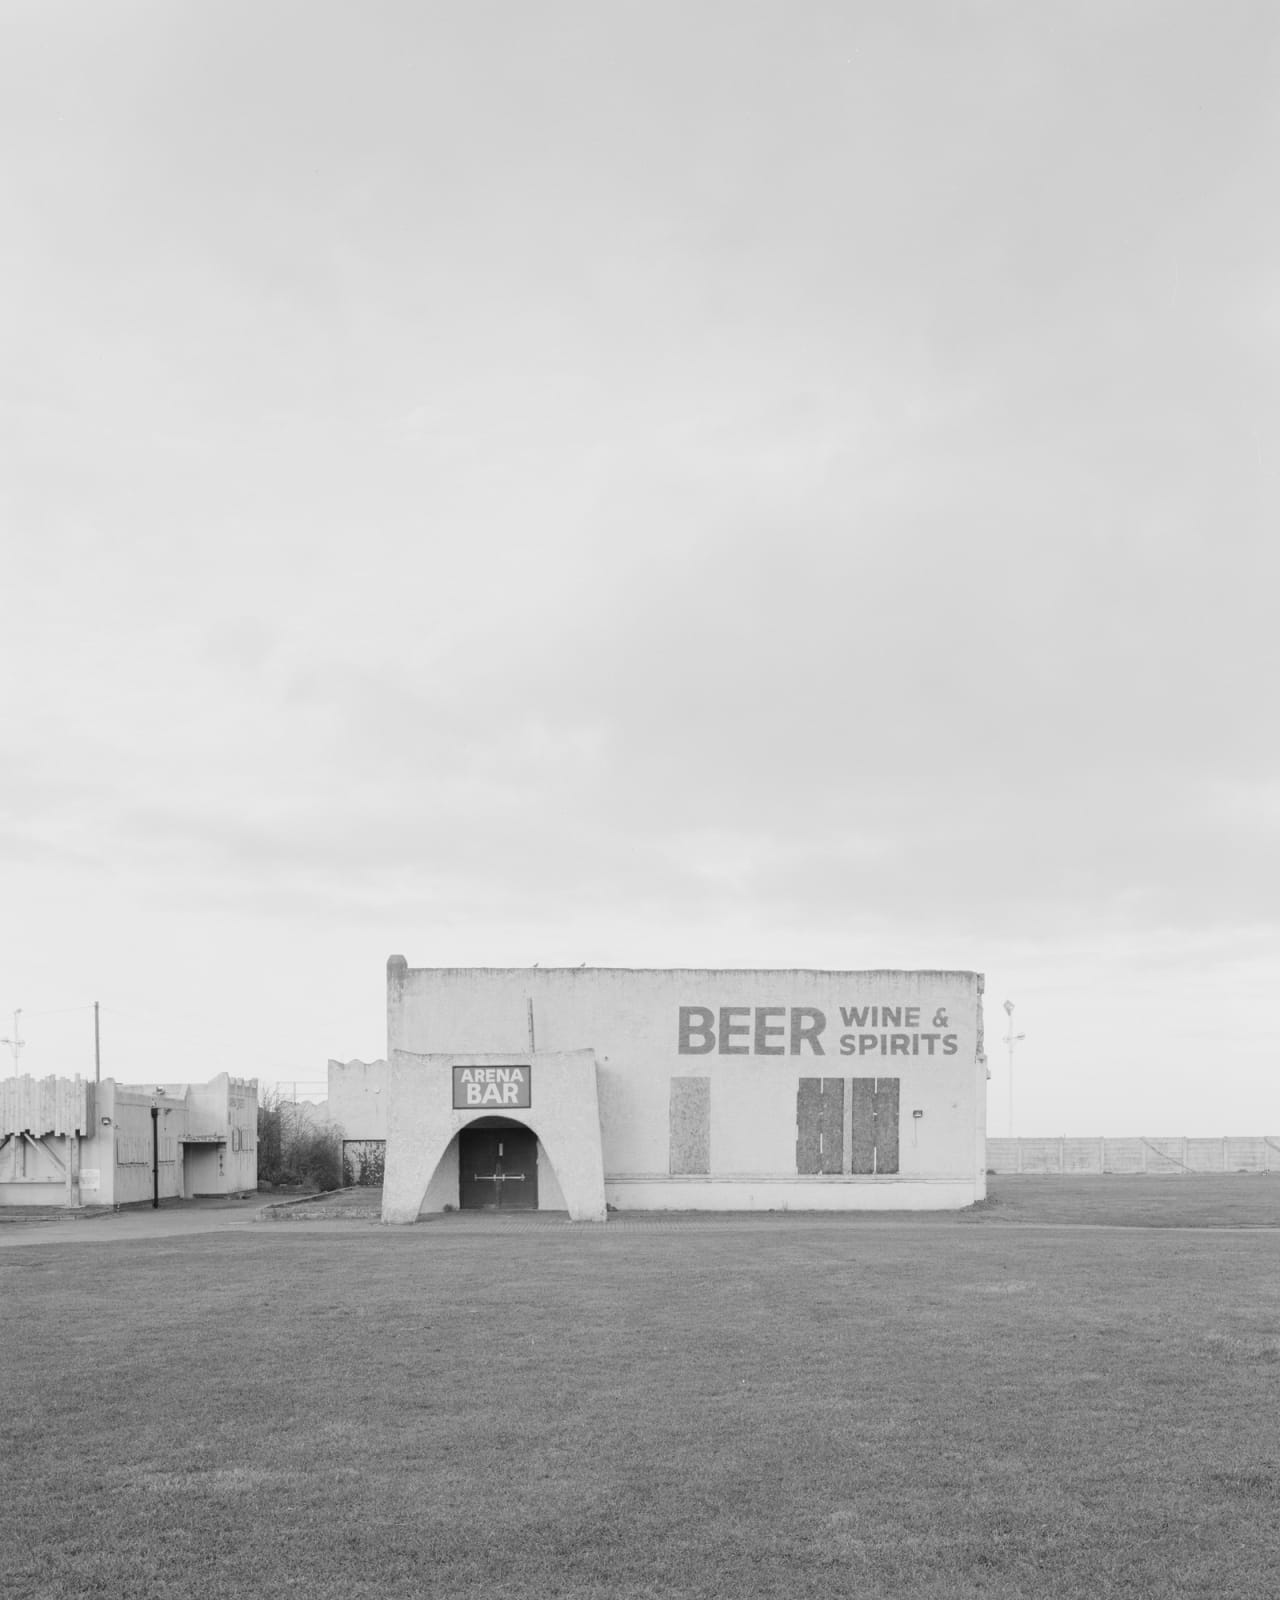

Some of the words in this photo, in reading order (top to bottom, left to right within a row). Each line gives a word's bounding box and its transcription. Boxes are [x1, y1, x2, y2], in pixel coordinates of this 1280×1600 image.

[839, 1006, 921, 1027] WINE
[932, 1007, 949, 1028] &
[678, 1006, 827, 1056] BEER
[839, 1034, 958, 1056] SPIRITS
[460, 1068, 524, 1083] ARENA
[467, 1083, 519, 1105] BAR
